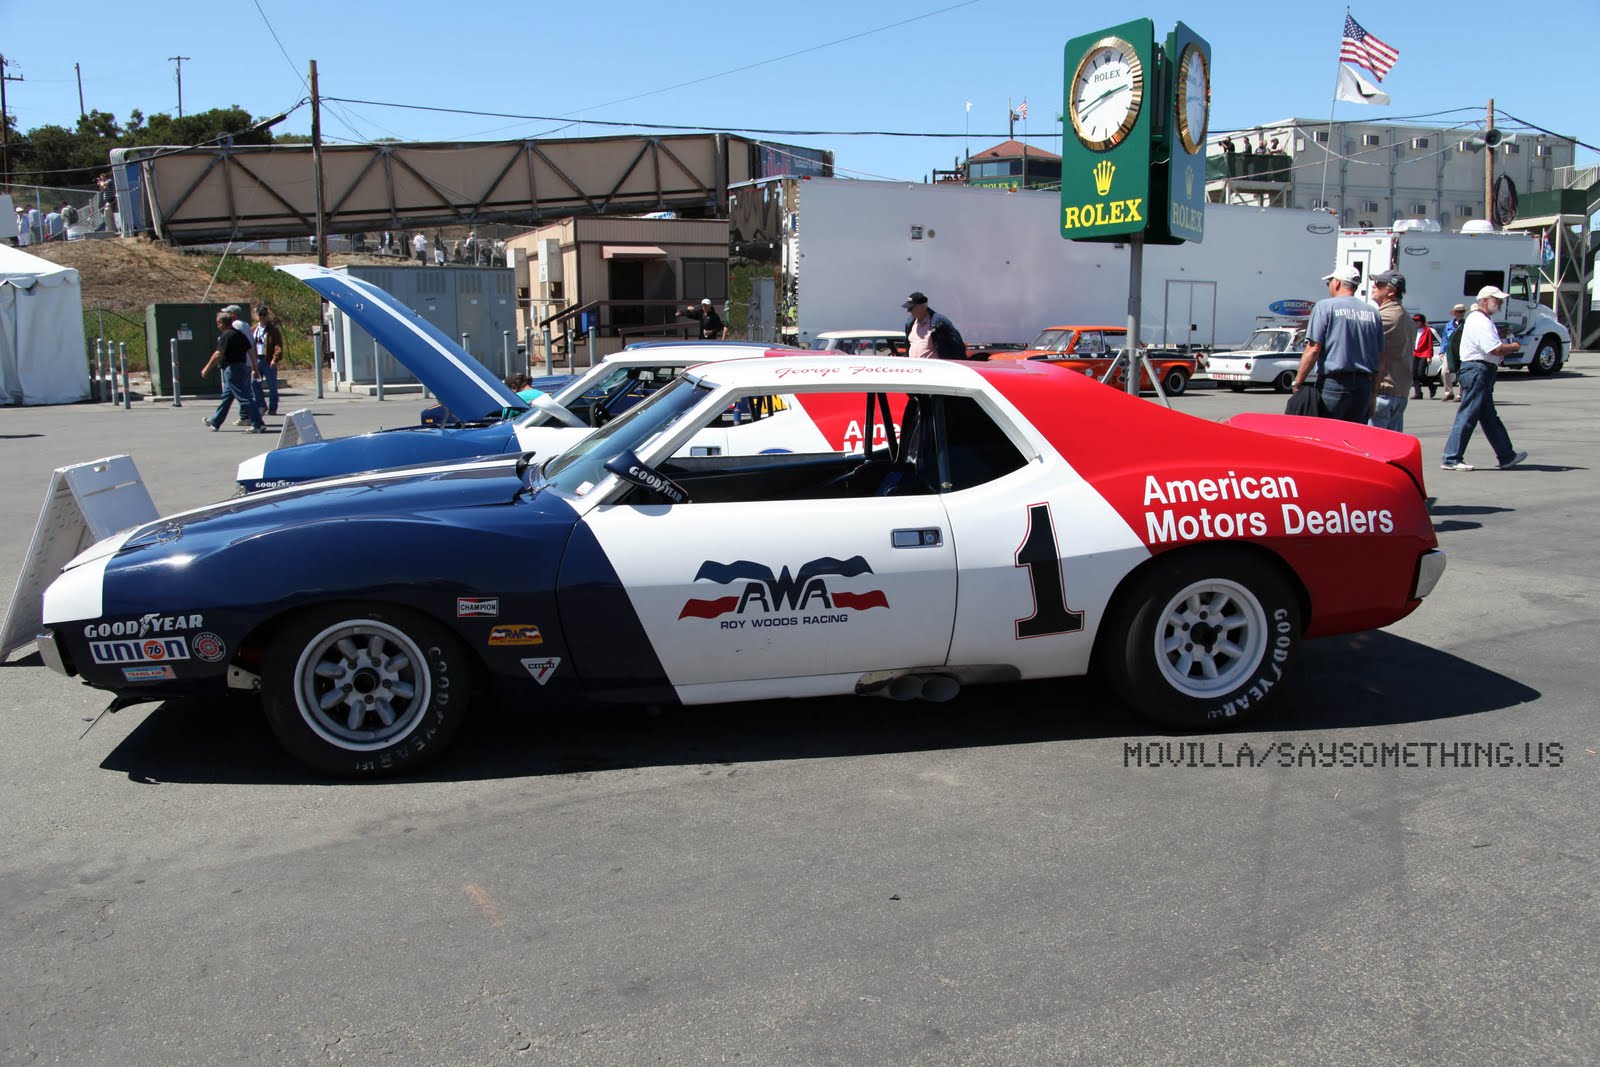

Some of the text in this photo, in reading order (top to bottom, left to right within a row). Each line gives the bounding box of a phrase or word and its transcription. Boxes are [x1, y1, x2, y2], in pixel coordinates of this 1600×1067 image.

[1094, 70, 1121, 83] ROLEX
[1065, 198, 1143, 229] ROLEX
[1171, 201, 1203, 233] ROLEX
[775, 366, 841, 379] George
[629, 466, 684, 504] GOODYEAR
[1143, 470, 1299, 506] American
[1144, 501, 1394, 545] Motors Dealers
[1014, 501, 1085, 641] 1
[460, 603, 497, 611] CHAMPION
[84, 613, 204, 638] GOODYEAR
[720, 613, 849, 630] ROY WOODS RACING
[147, 644, 162, 656] 76
